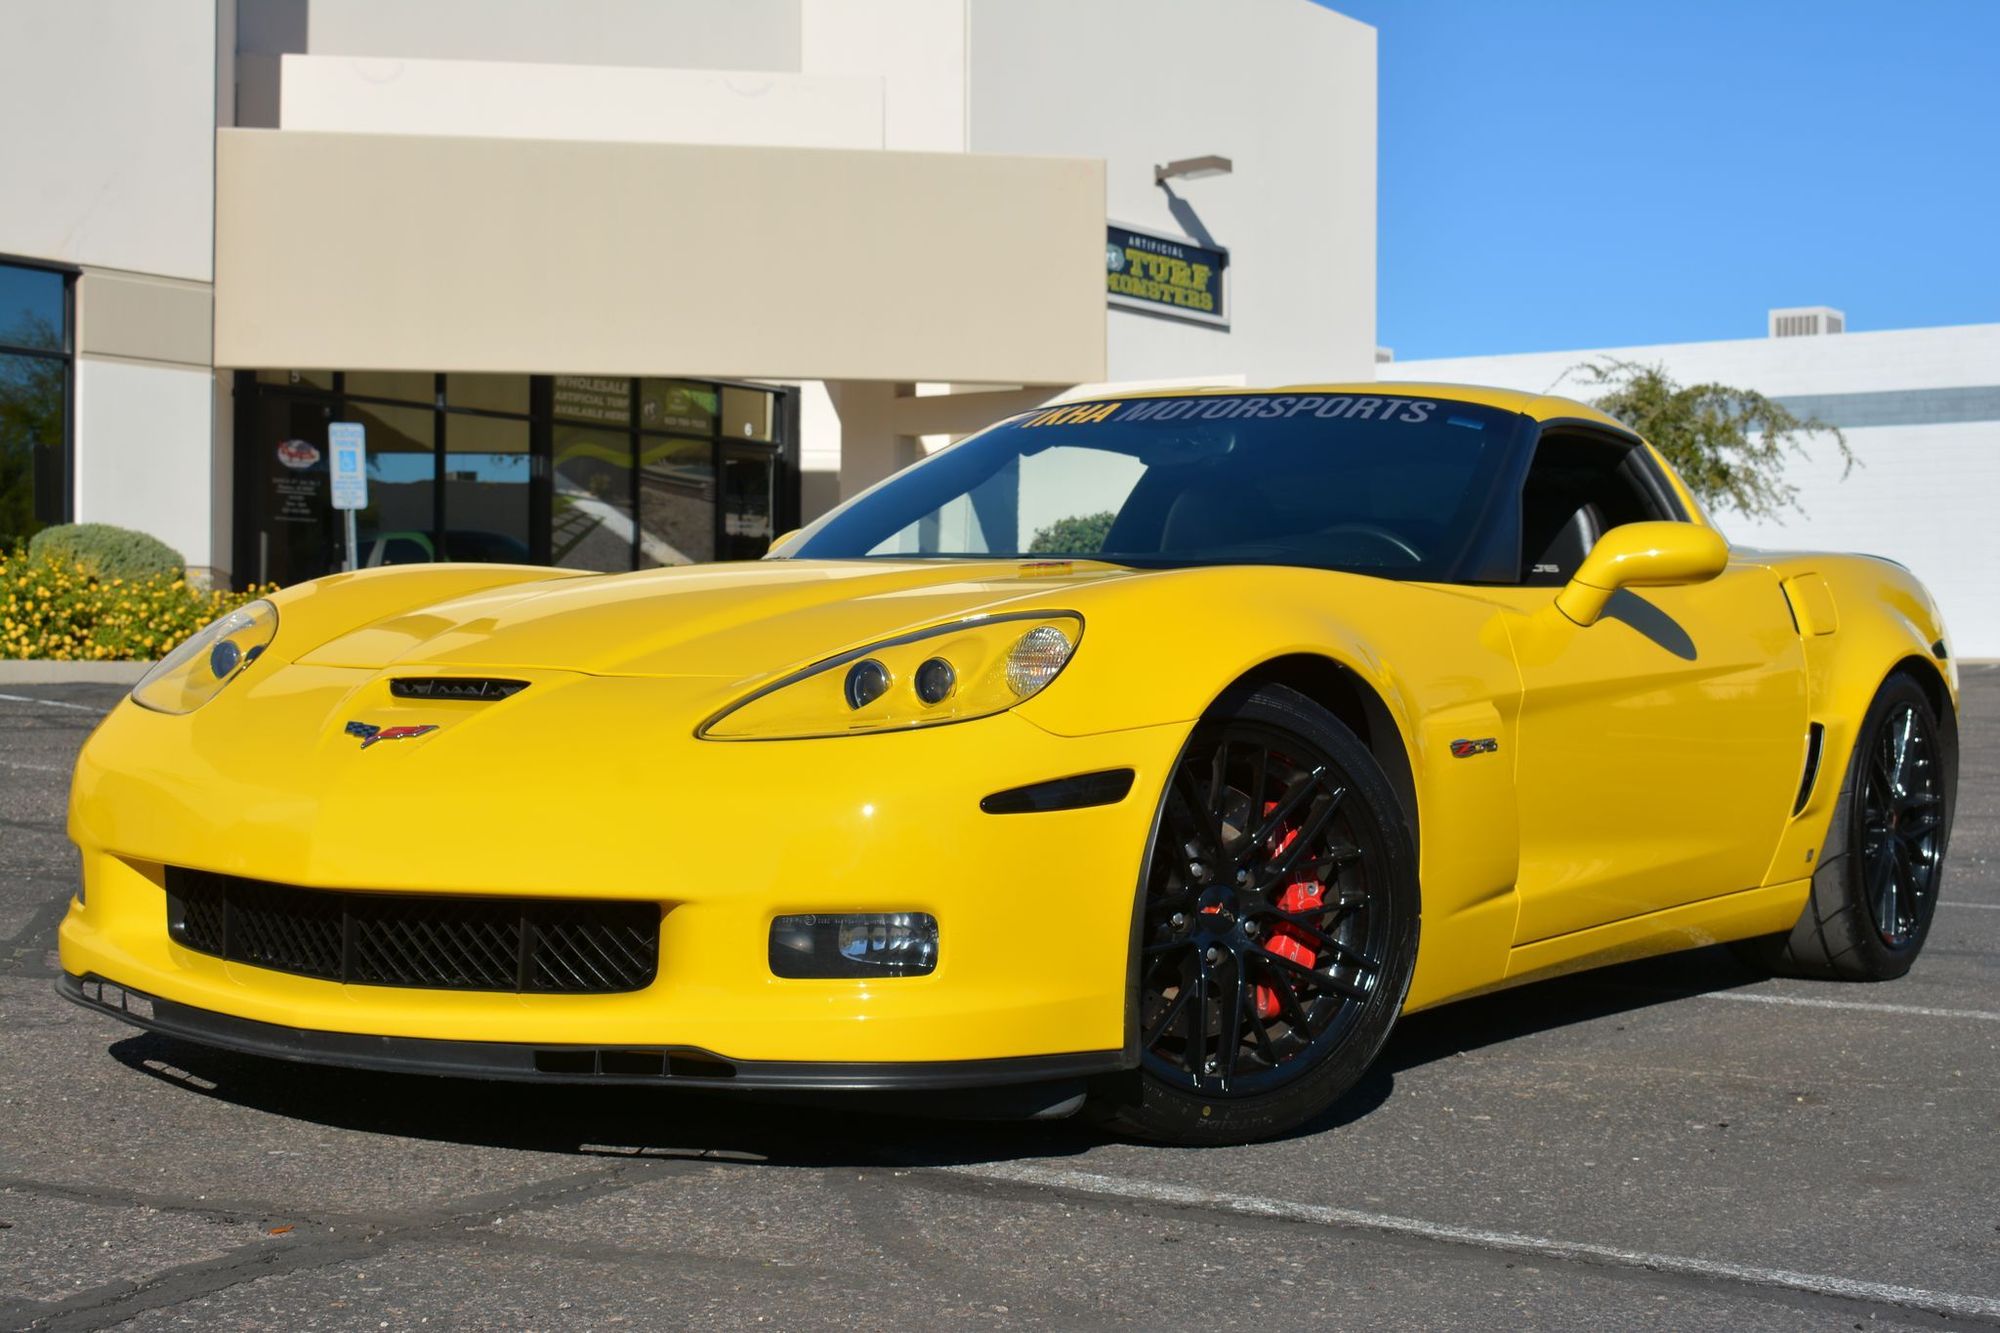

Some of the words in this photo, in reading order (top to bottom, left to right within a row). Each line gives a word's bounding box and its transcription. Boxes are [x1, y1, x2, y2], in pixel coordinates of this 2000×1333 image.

[1128, 236, 1184, 258] ARTIFICIAL
[1125, 248, 1212, 291] TURF
[556, 376, 629, 395] WHOLESALE
[1012, 402, 1121, 429] IKHA
[1114, 397, 1438, 424] MOTORSPORTS
[744, 422, 753, 436] 6
